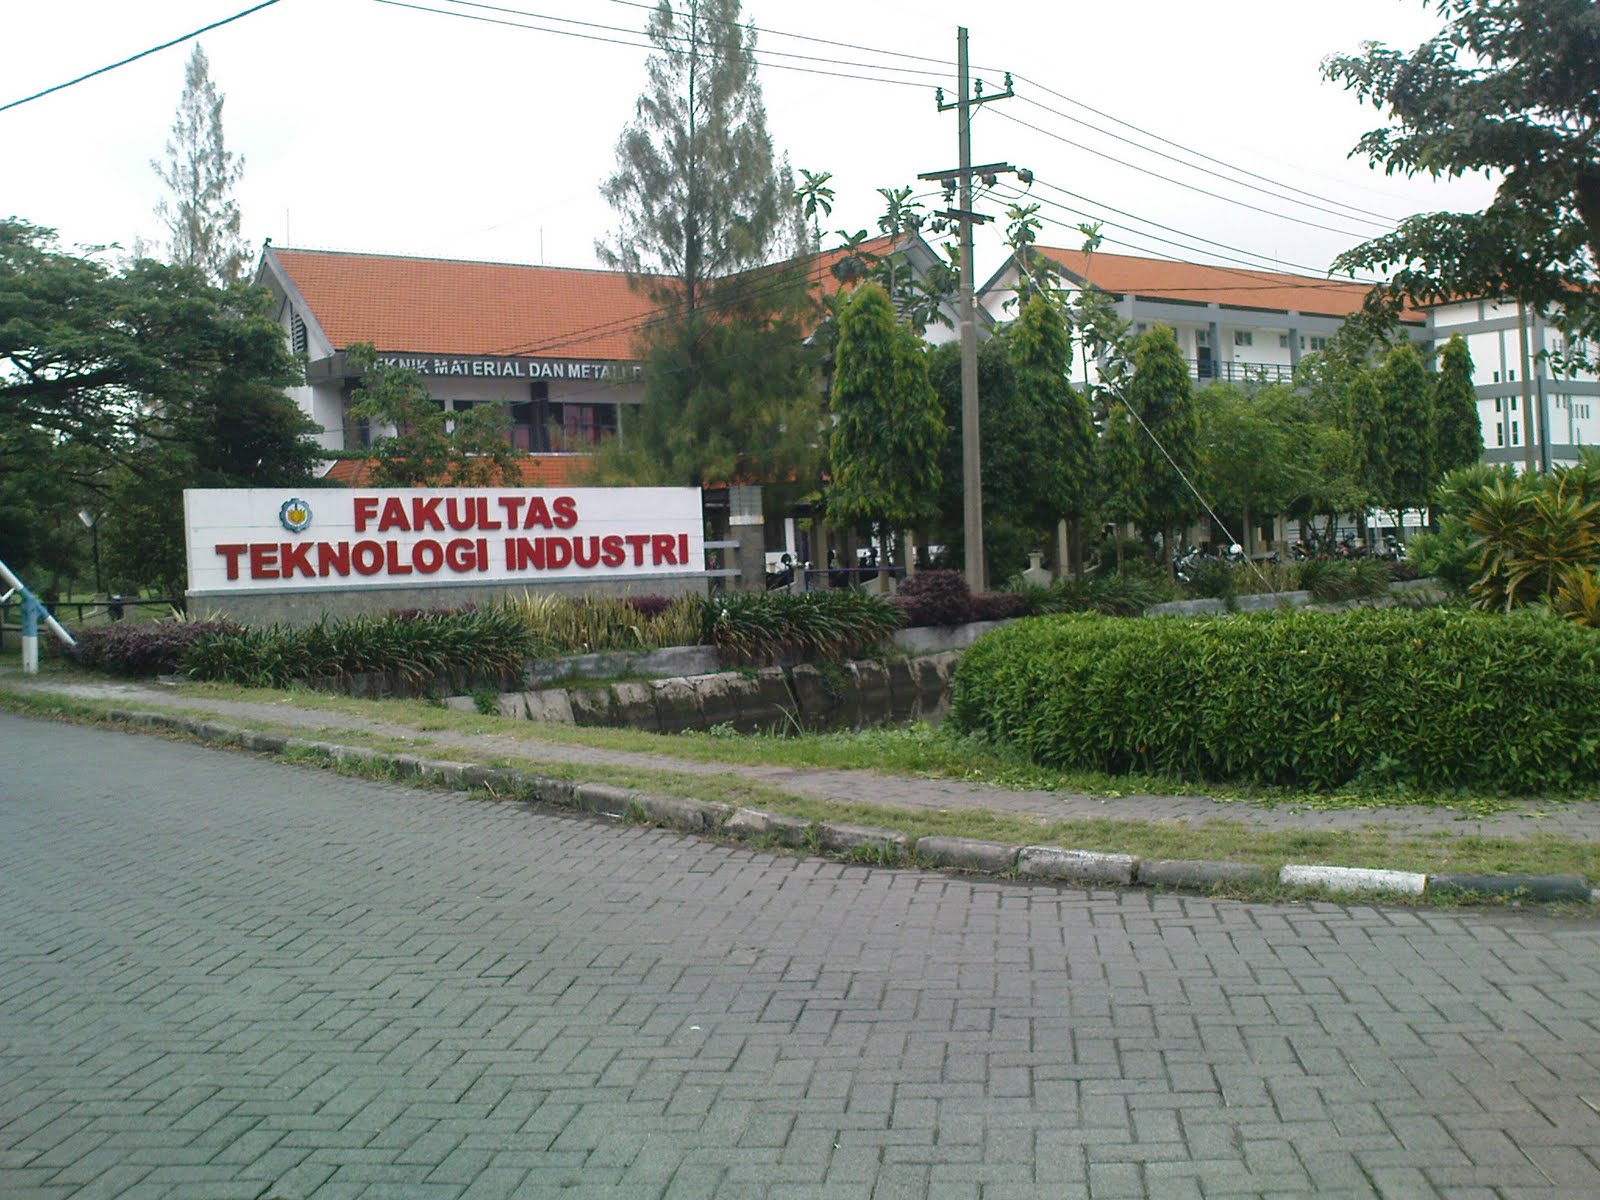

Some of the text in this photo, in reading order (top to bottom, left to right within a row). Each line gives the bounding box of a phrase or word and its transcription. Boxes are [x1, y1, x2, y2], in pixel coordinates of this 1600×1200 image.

[363, 358, 429, 374] EKNIK
[434, 359, 525, 377] MATERIAL
[528, 362, 564, 378] DAN
[353, 496, 578, 532] FAKULTAS
[215, 533, 690, 581] TEKNOLOGI INDUSTRI
